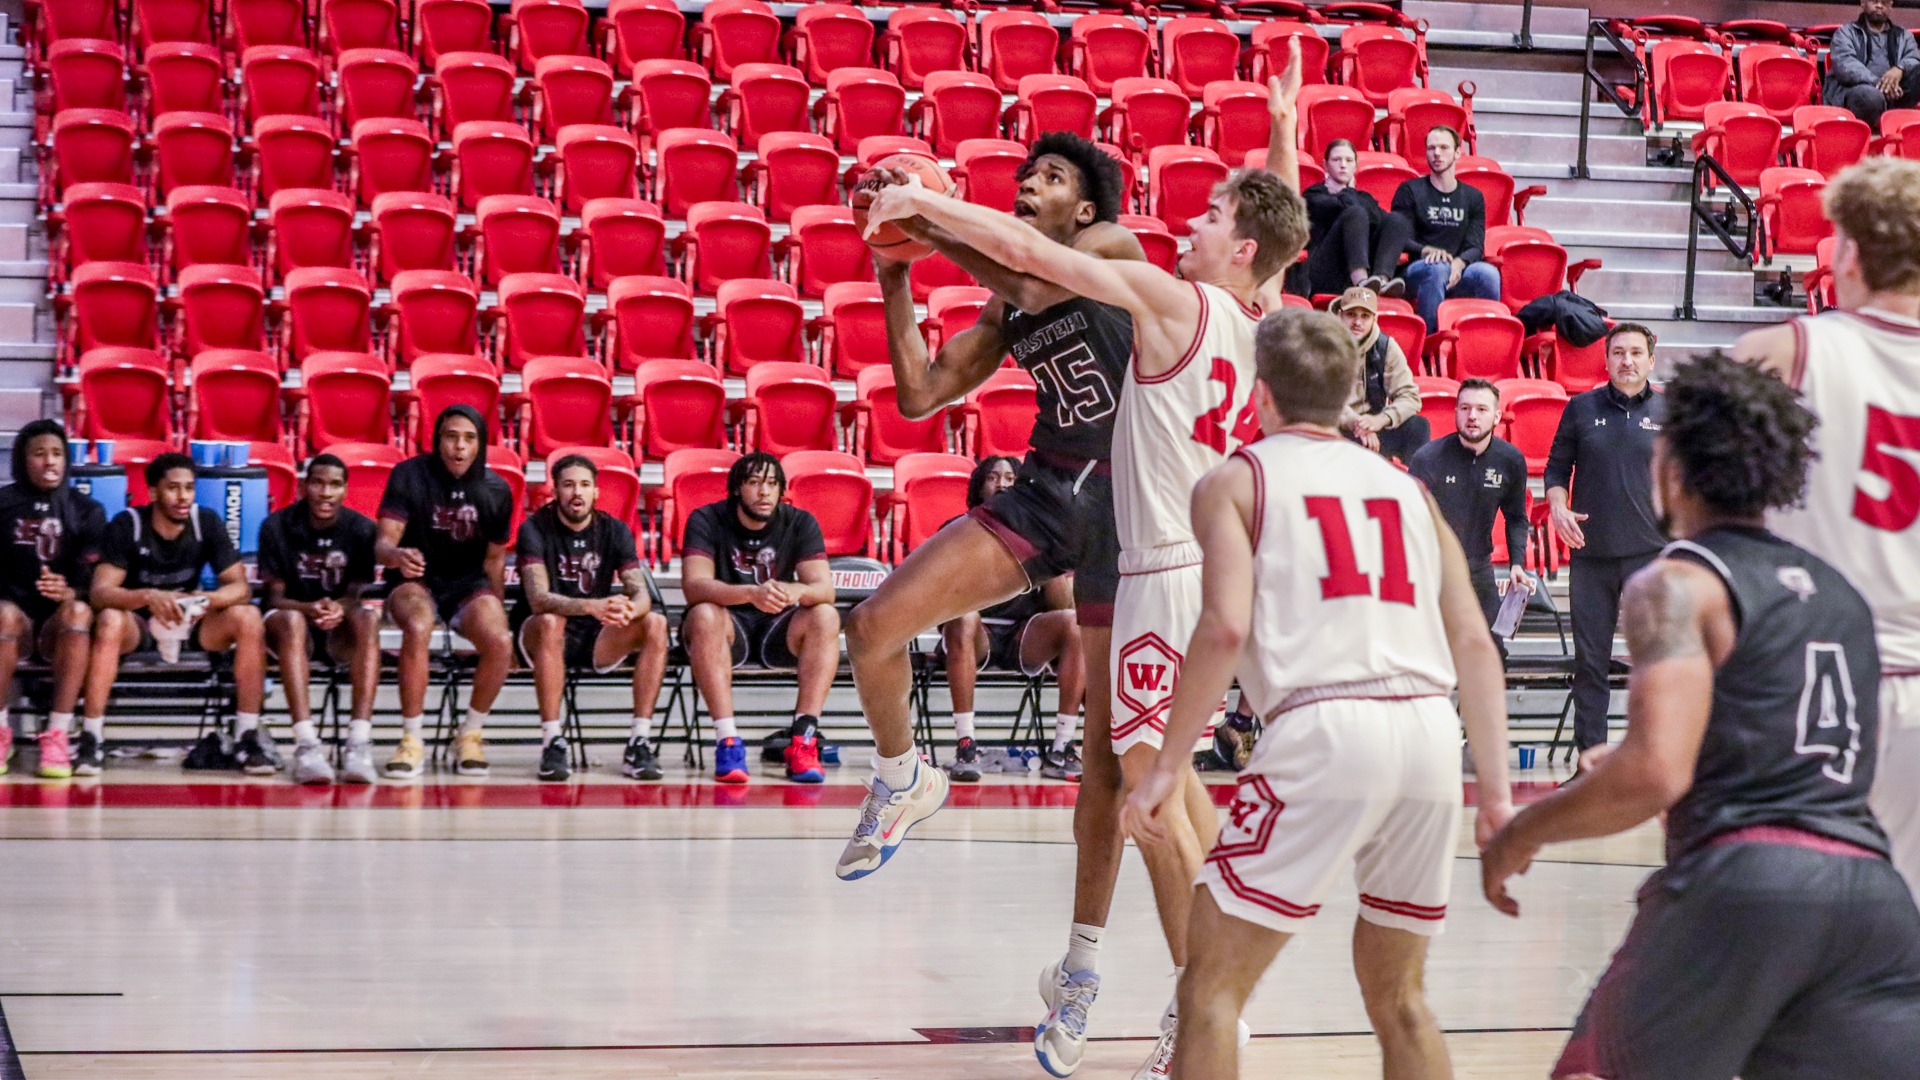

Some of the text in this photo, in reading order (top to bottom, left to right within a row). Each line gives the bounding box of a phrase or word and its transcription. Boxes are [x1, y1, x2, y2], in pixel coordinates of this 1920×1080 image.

[1031, 342, 1116, 427] 15
[1851, 403, 1920, 532] 5
[832, 573, 884, 587] THOLIC
[1303, 496, 1416, 608] 11
[1795, 641, 1861, 784] 4
